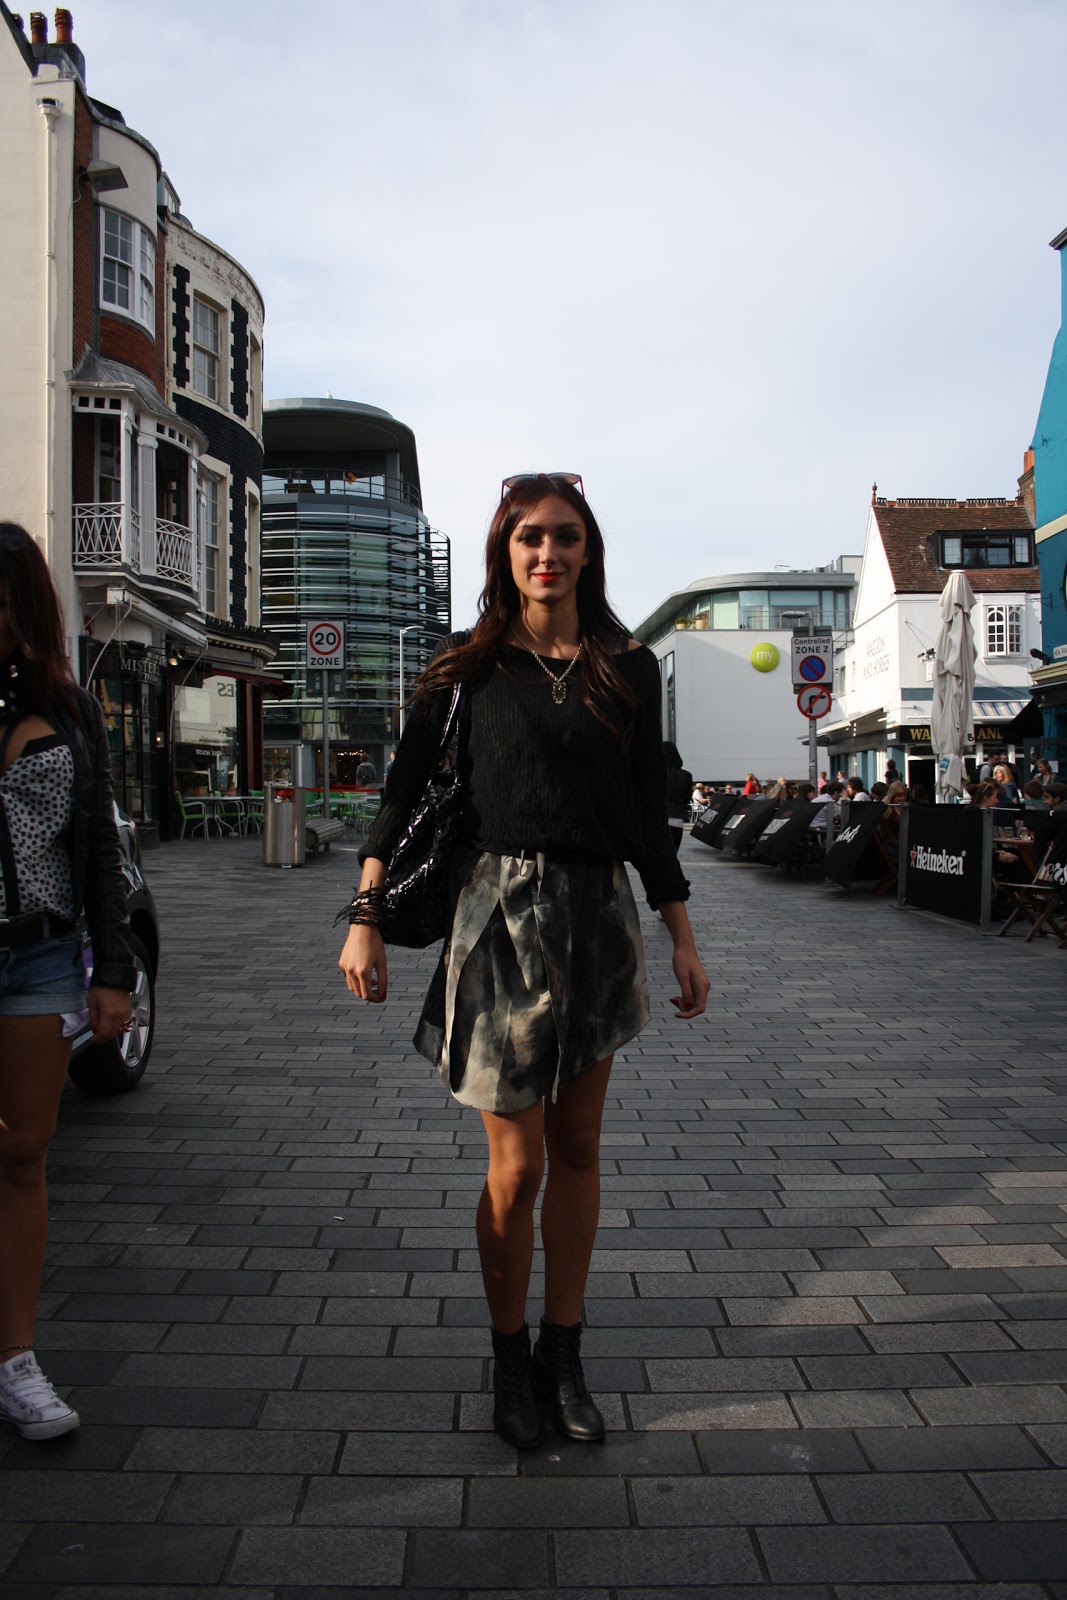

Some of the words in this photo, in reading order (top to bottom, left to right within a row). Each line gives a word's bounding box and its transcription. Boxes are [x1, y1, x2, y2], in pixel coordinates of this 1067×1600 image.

[314, 632, 337, 645] 20
[793, 637, 831, 645] Controlled
[795, 645, 821, 654] ZONE
[823, 645, 829, 653] Z
[310, 657, 340, 666] ZONE
[756, 651, 774, 662] my
[915, 845, 964, 876] Heineken
